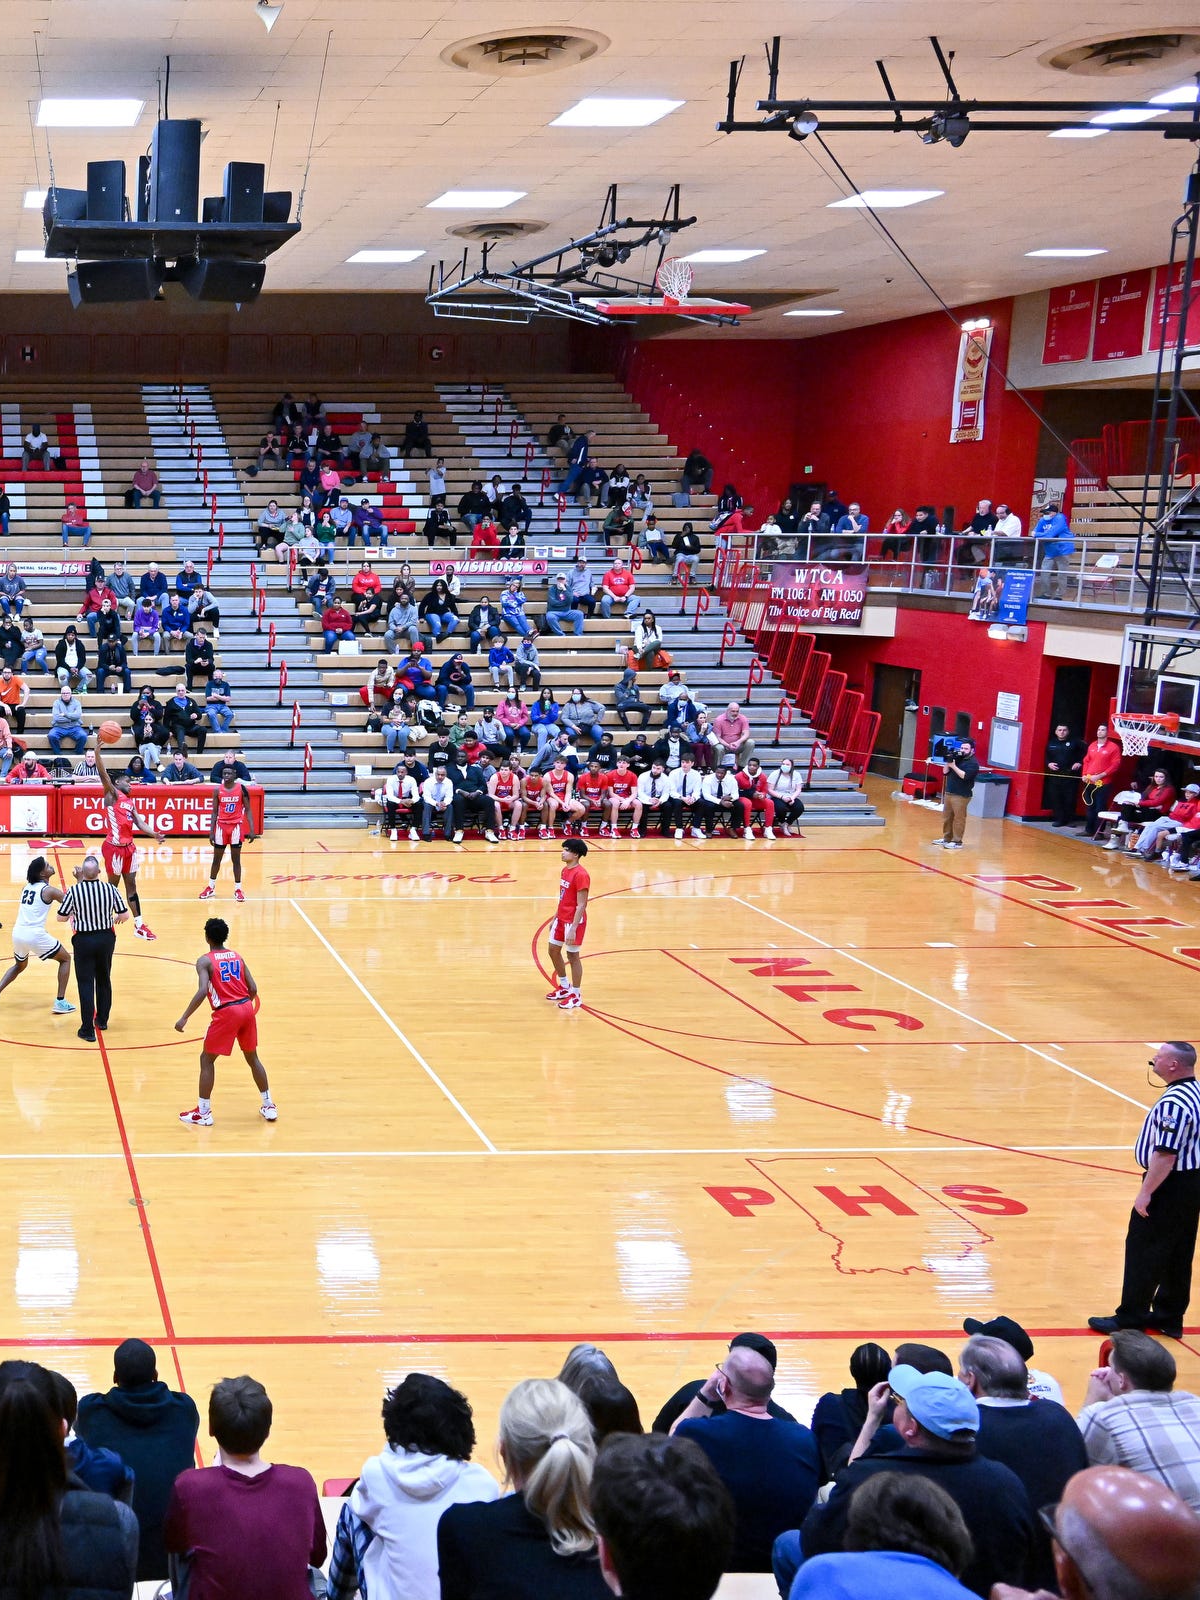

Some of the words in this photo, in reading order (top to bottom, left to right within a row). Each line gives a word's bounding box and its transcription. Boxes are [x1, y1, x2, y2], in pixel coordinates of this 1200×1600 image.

[21, 347, 34, 361] H
[435, 563, 443, 571] A
[454, 561, 524, 573] VISITORS
[535, 563, 542, 571] A
[795, 568, 843, 584] WTCA
[771, 588, 784, 599] FM
[787, 588, 811, 600] 106.1
[820, 589, 835, 601] AM
[839, 590, 863, 602] 1050
[787, 606, 810, 617] Voice
[812, 607, 823, 618] of
[823, 607, 838, 621] Big
[839, 608, 861, 620] Red!
[225, 803, 236, 813] 10
[21, 889, 36, 905] 23
[964, 874, 1200, 970] PIL
[219, 959, 241, 982] 24
[727, 957, 924, 1032] NLC
